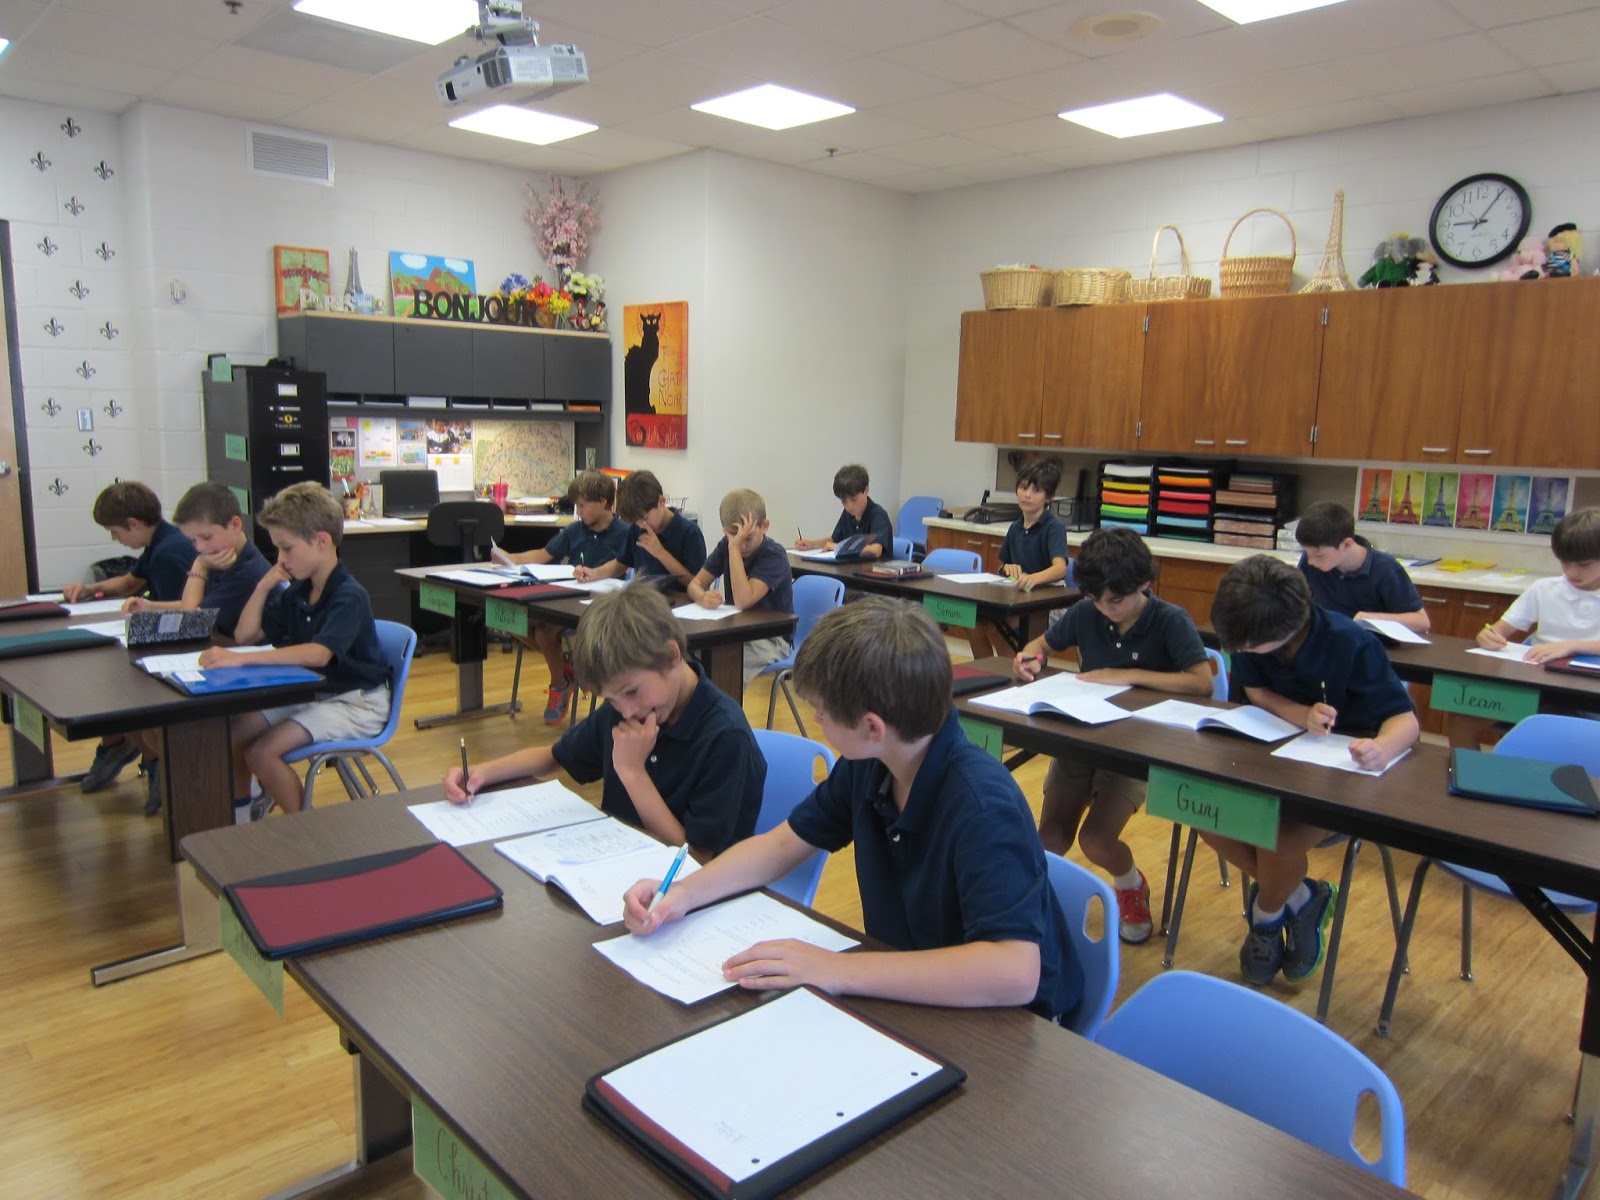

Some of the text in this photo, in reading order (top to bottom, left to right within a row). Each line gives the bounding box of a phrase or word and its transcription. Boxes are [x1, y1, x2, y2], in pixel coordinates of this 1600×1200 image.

[1462, 191, 1472, 204] 11
[1476, 185, 1489, 200] 12
[1506, 197, 1514, 209] 2
[1449, 204, 1464, 218] 10
[1442, 220, 1451, 231] 9
[1446, 232, 1454, 246] 8
[1501, 227, 1509, 240] 4
[1458, 242, 1466, 256] 7
[1472, 244, 1481, 258] 6
[1489, 239, 1498, 250] 5
[413, 288, 541, 327] BONJOUR
[1453, 684, 1505, 712] Jean
[1176, 782, 1219, 829] Guy
